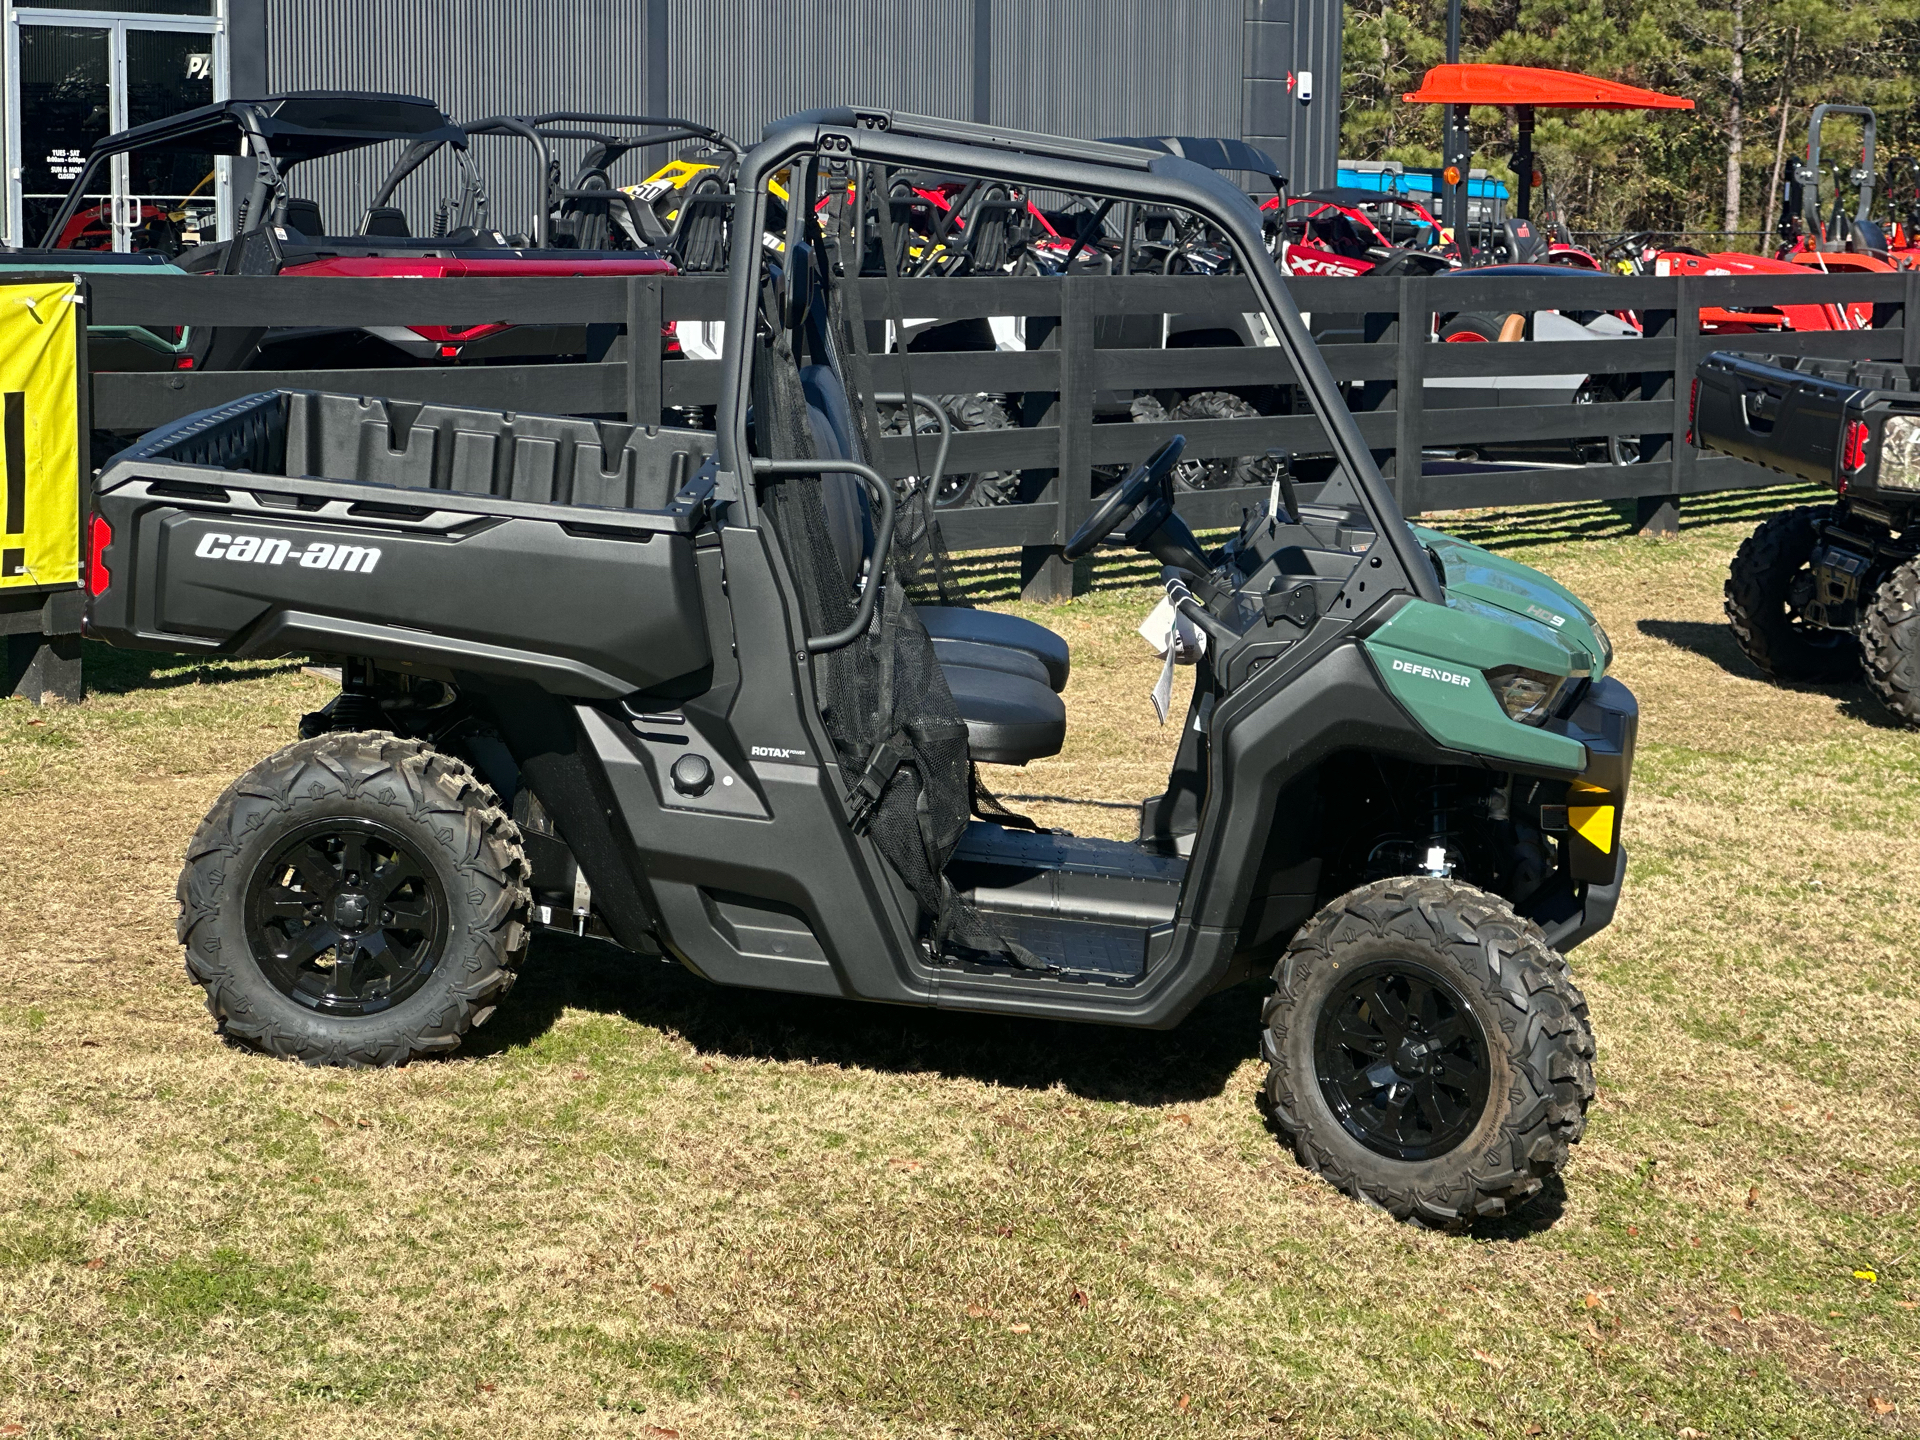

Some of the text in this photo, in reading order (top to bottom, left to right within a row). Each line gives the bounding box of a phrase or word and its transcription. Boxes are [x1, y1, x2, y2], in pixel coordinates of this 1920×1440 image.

[52, 149, 66, 157] TUES
[70, 149, 80, 157] SAT
[1291, 254, 1358, 277] XRS
[195, 532, 382, 573] can-am
[1526, 604, 1566, 627] HD9
[1392, 659, 1471, 688] DEFENDER
[751, 746, 790, 758] ROTAX
